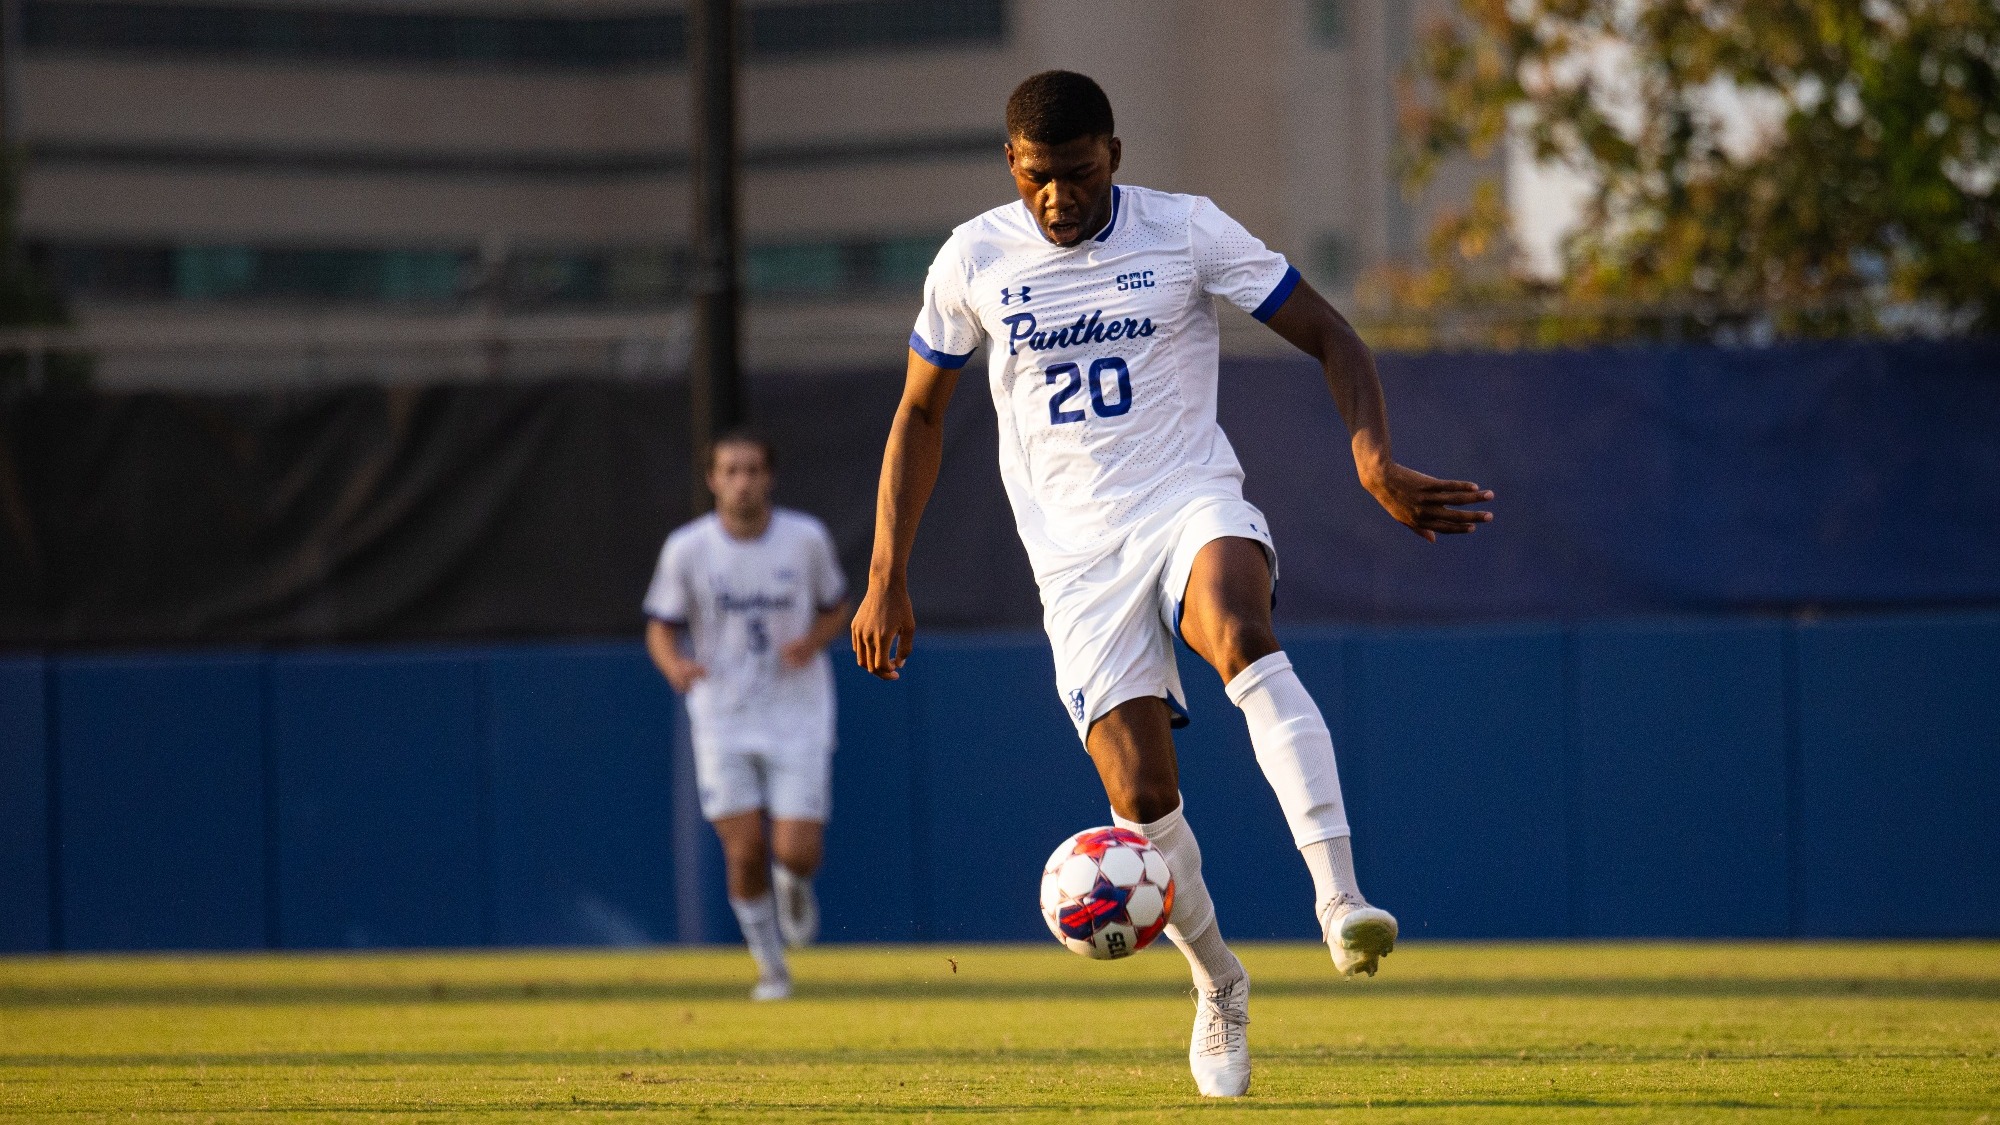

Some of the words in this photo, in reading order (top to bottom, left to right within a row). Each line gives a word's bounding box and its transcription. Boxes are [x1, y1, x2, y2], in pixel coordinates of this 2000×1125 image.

[1116, 270, 1156, 292] SBC
[1001, 309, 1158, 356] Panthers
[1045, 356, 1133, 426] 20
